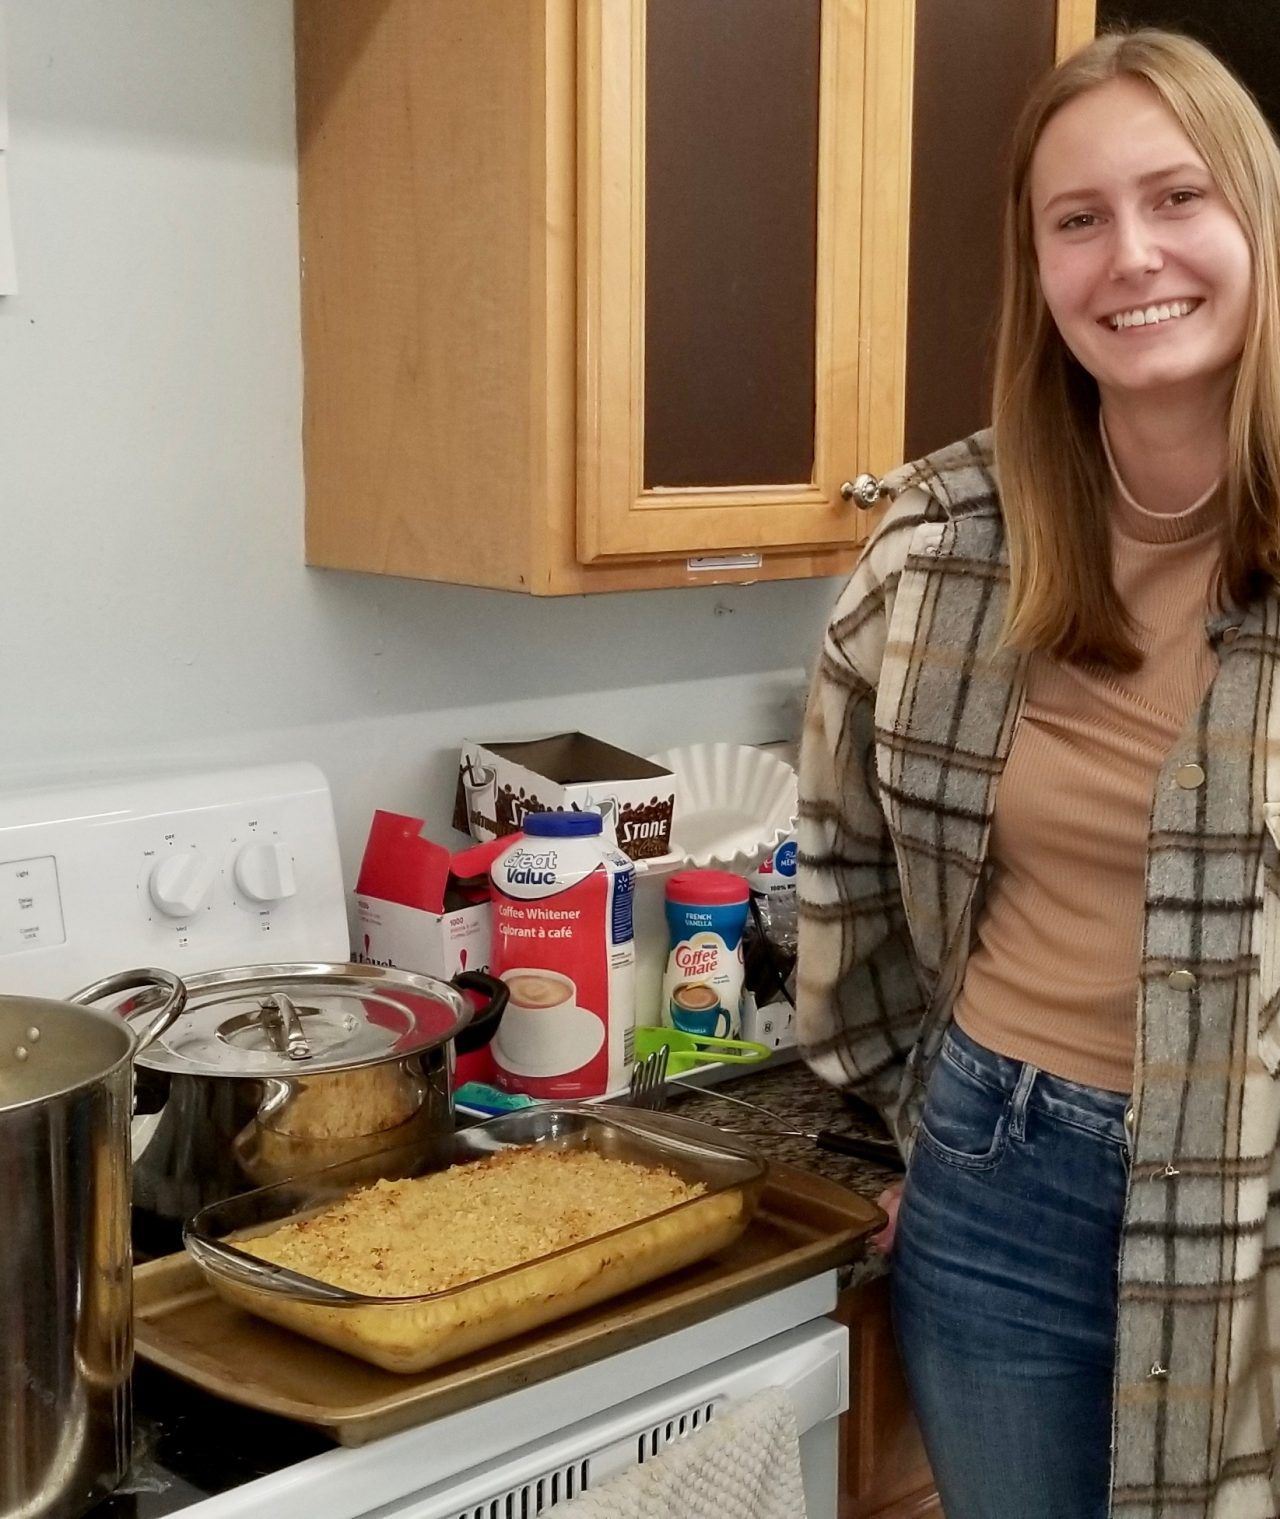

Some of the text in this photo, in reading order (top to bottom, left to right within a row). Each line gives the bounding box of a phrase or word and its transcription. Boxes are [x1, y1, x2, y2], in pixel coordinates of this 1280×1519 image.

[621, 819, 667, 843] STONE
[504, 849, 557, 869] Great
[507, 868, 556, 885] Value
[499, 904, 580, 920] Coffee Whitener
[685, 912, 712, 921] FRENCH
[499, 922, 573, 938] Colorant à café
[685, 919, 713, 927] VANILLA
[675, 945, 718, 969] Coffee
[683, 961, 718, 977] mate
